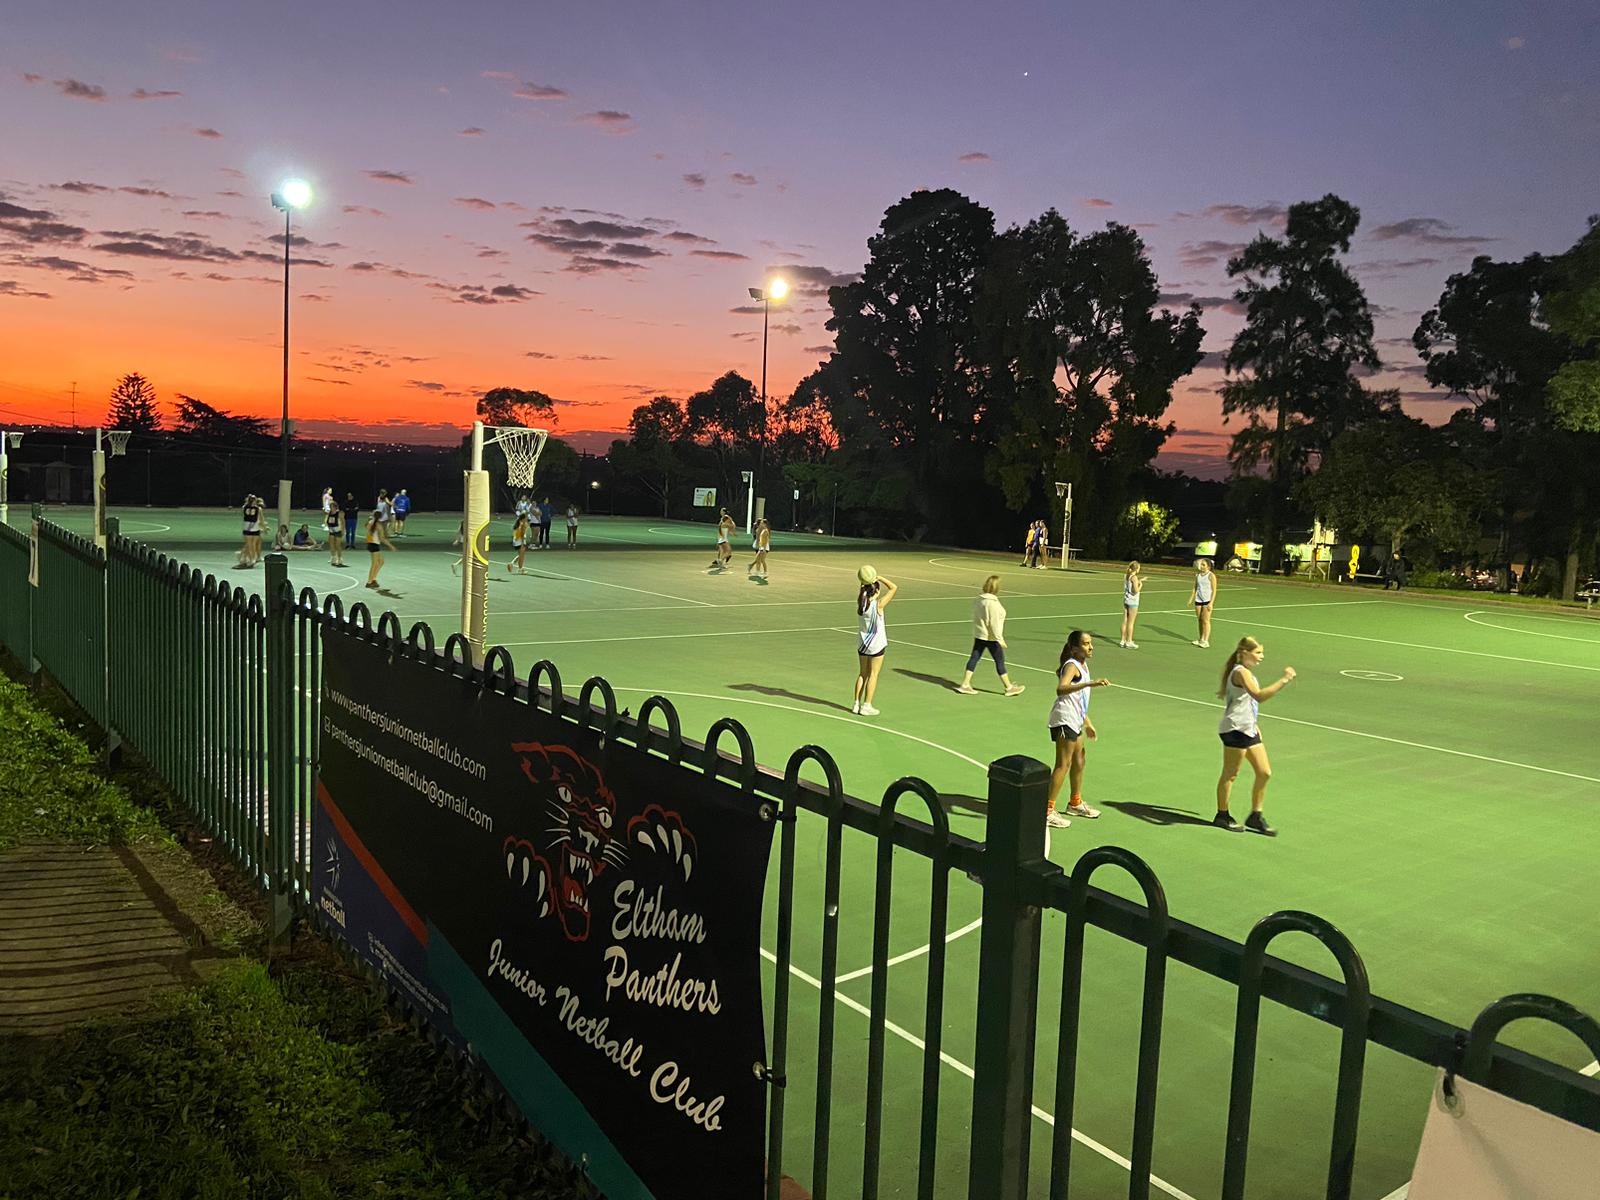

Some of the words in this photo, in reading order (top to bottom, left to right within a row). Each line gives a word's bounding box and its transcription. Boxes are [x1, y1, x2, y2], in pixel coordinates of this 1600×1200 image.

[331, 689, 486, 780] www.panthersjuniornetballclub.com
[331, 723, 493, 832] panthersjuniornetballclub@gmail.com
[321, 896, 346, 928] netball
[612, 880, 706, 943] Eltham
[604, 945, 721, 1015] Panthers
[488, 939, 546, 1006] Junior
[556, 985, 643, 1077] Netball
[649, 1061, 725, 1131] Club
